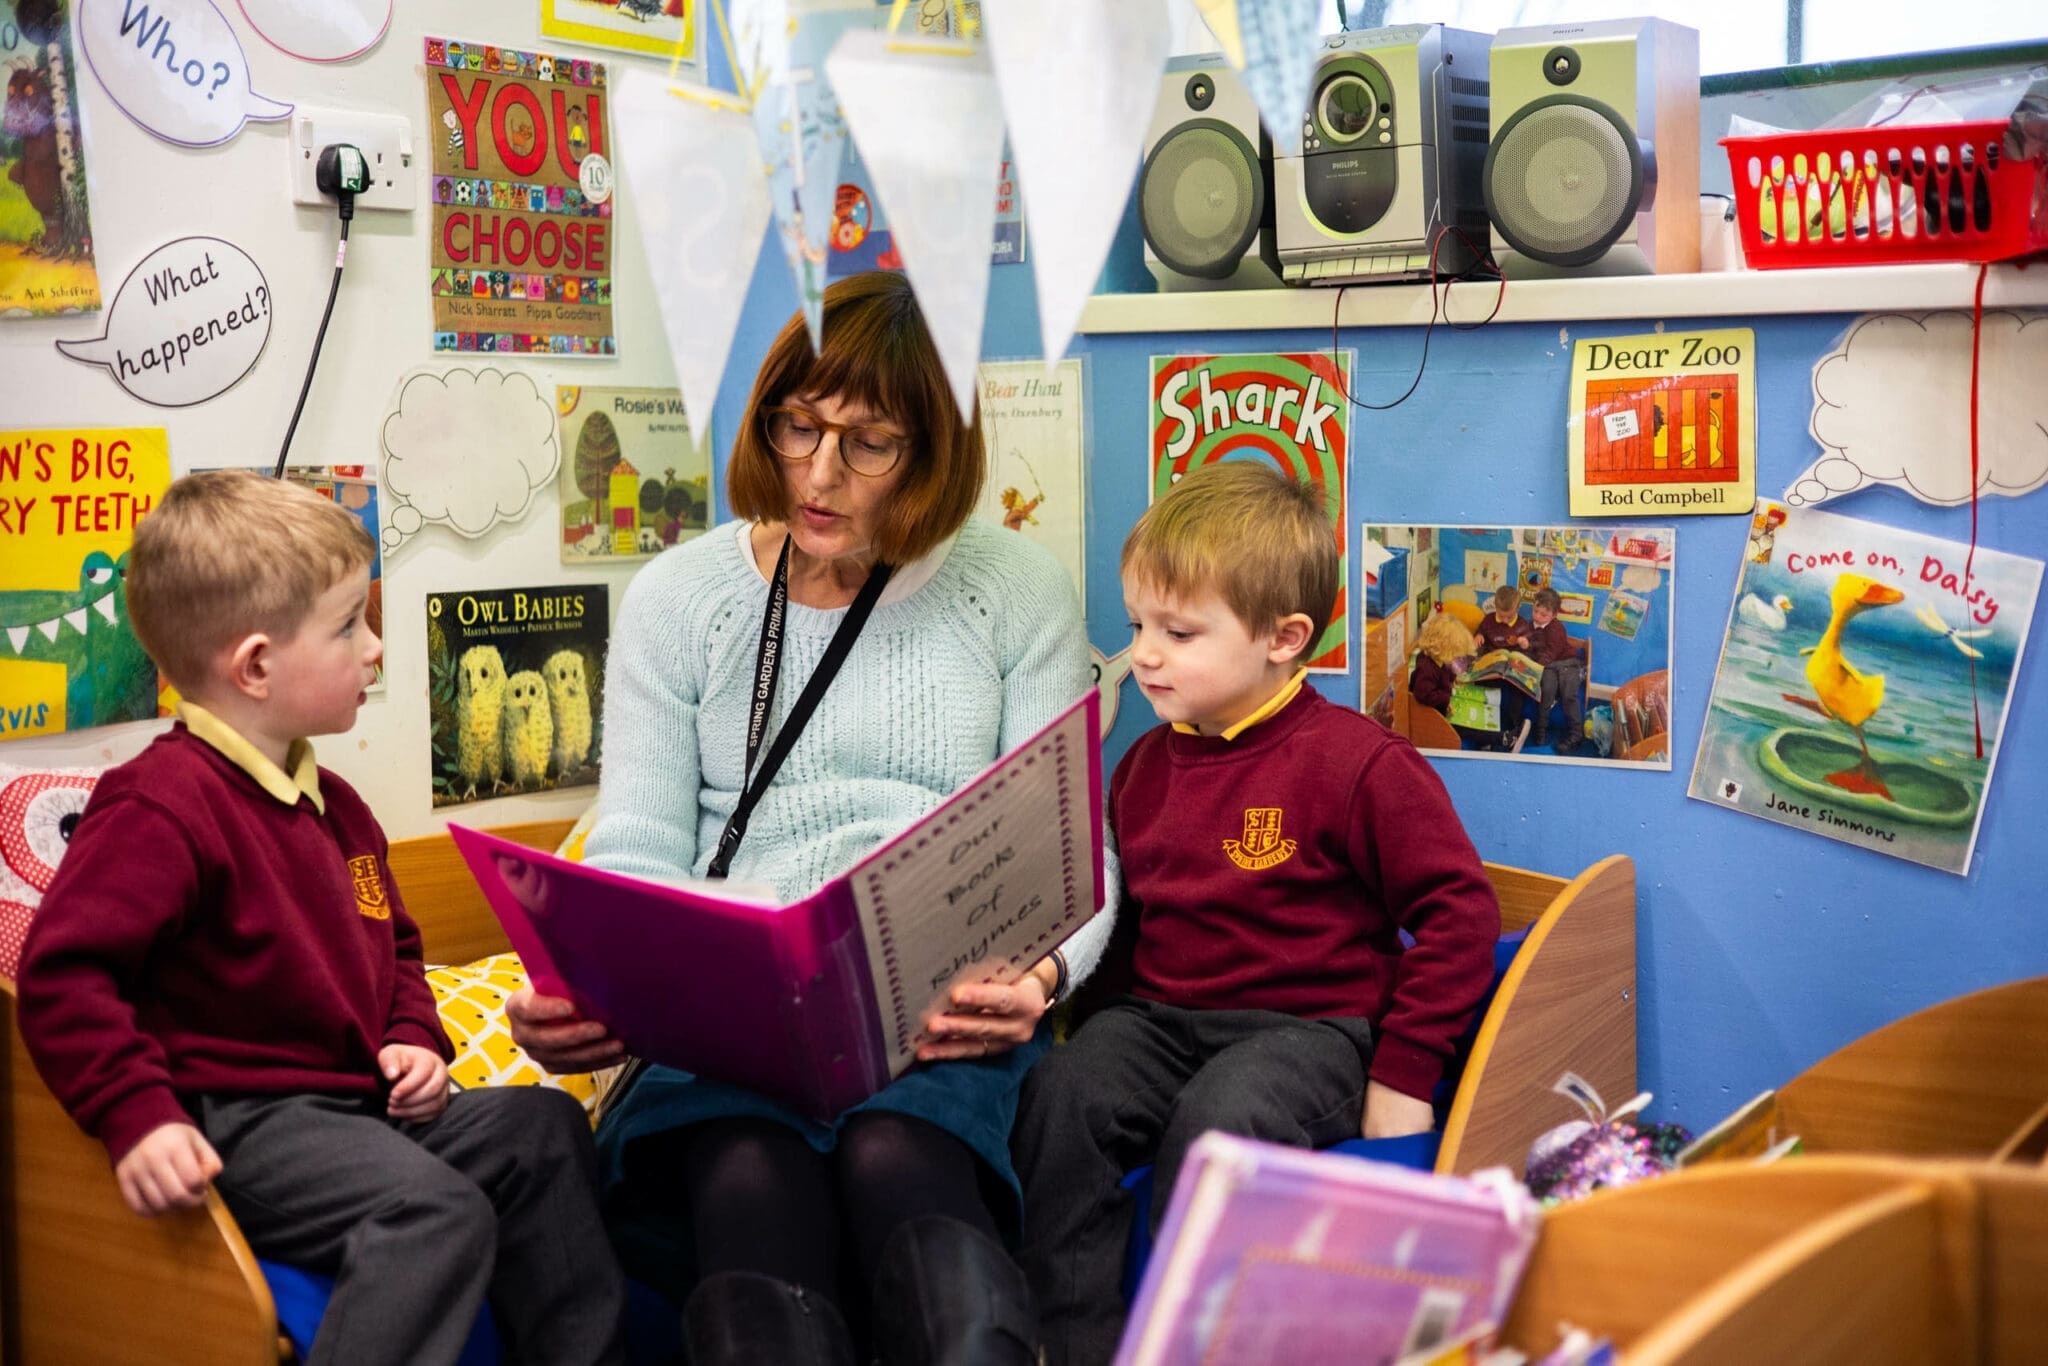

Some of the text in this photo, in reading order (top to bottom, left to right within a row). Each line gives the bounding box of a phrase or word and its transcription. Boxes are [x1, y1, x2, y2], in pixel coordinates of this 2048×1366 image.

[119, 0, 231, 101] Who?
[438, 73, 601, 182] YOU
[589, 166, 605, 186] 10
[1332, 160, 1359, 170] PHILIPS
[443, 212, 606, 272] CHOOSE
[143, 252, 220, 306] What
[116, 285, 269, 381] happened?
[448, 302, 473, 316] Nick
[476, 302, 517, 318] Sharratt
[526, 305, 553, 320] Pippa
[1586, 338, 1741, 372] Dear Zoo
[614, 397, 665, 415] Rosie's
[984, 378, 1063, 399] Bear Hunt
[1159, 367, 1340, 460] Shark
[1611, 415, 1627, 423] FROM
[71, 437, 135, 484] BIG,
[50, 492, 151, 536] TEETH
[1600, 488, 1726, 508] Rod Campbell
[457, 592, 585, 626] OWL BABIES
[1787, 550, 2000, 625] Come on, Daisy
[750, 702, 766, 748] SPRING
[758, 640, 778, 700] GARDENS
[768, 584, 786, 639] PRIMARY
[948, 814, 1005, 866] Our
[1766, 793, 1897, 843] Jane Simmons
[943, 845, 1017, 905] Book
[966, 884, 1004, 927] of
[929, 894, 1043, 991] Rhymes
